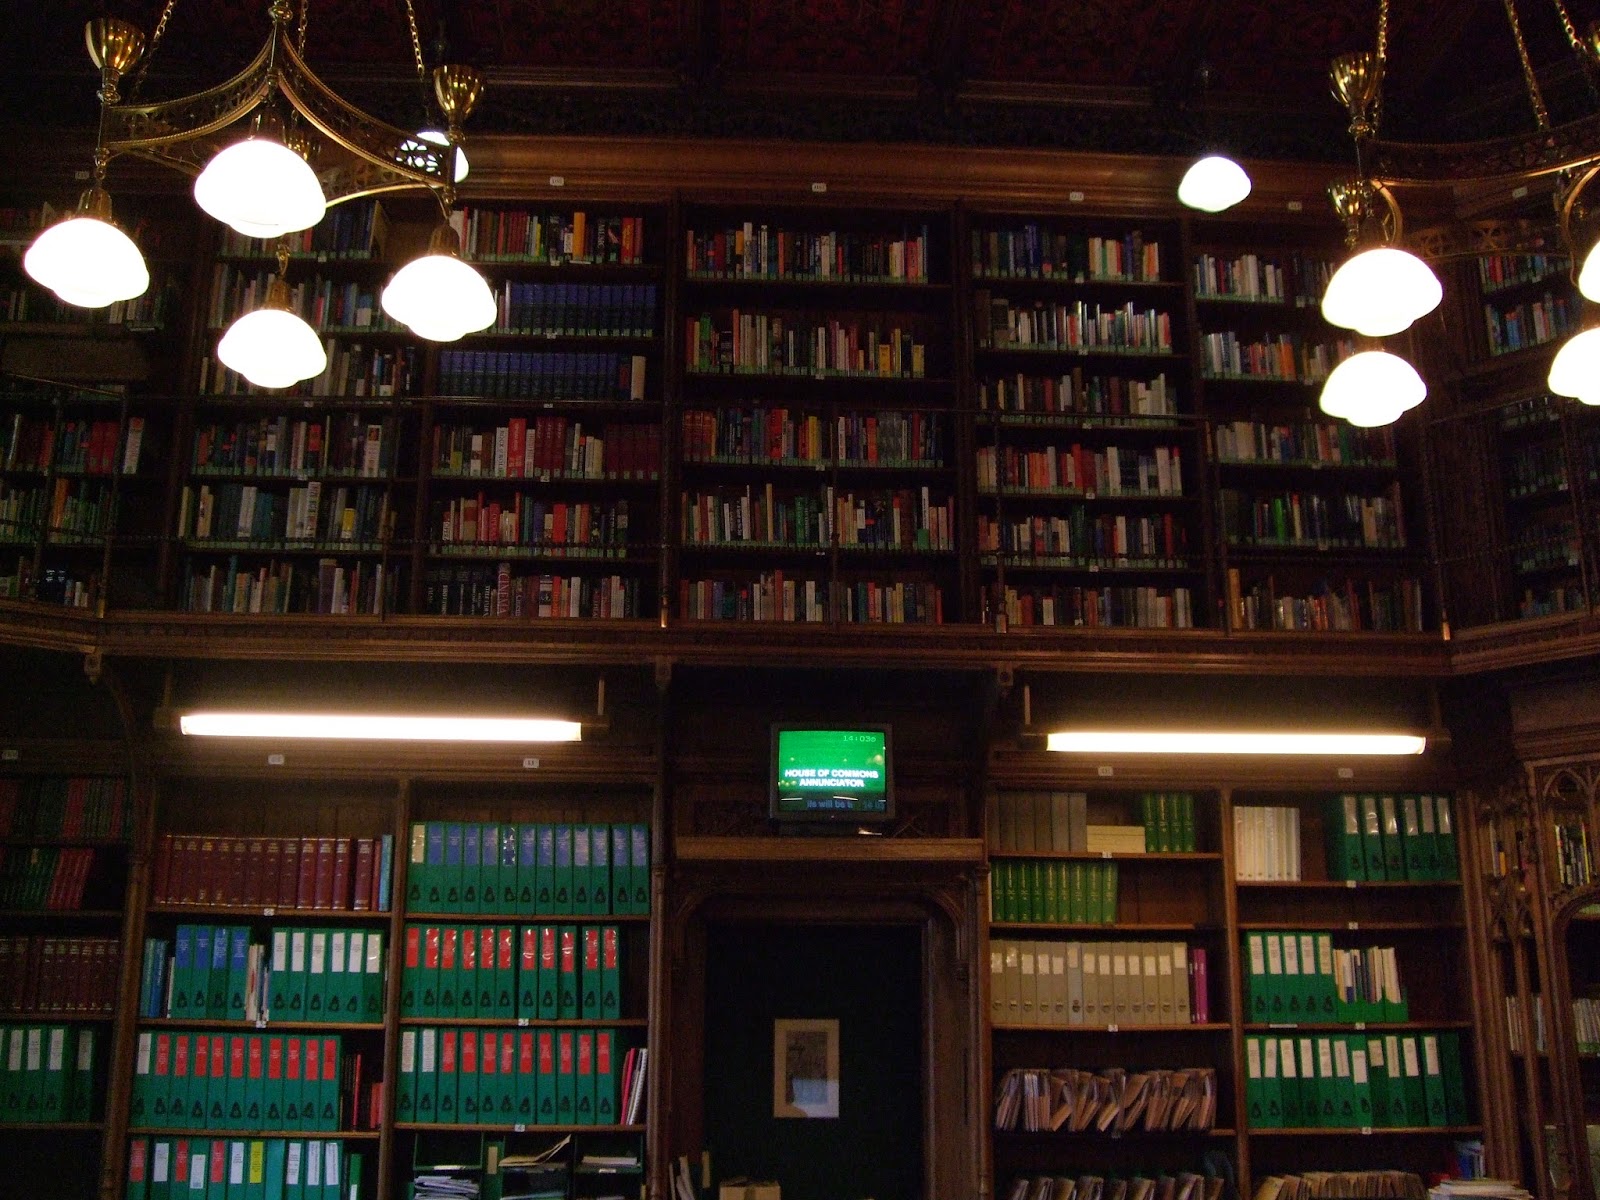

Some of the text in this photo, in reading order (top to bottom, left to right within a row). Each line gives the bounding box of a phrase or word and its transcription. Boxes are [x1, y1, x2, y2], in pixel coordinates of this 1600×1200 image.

[497, 573, 510, 614] CINEMA
[785, 769, 879, 779] HOUSE OF COMMONS
[799, 778, 865, 788] ANNUNCIATOR
